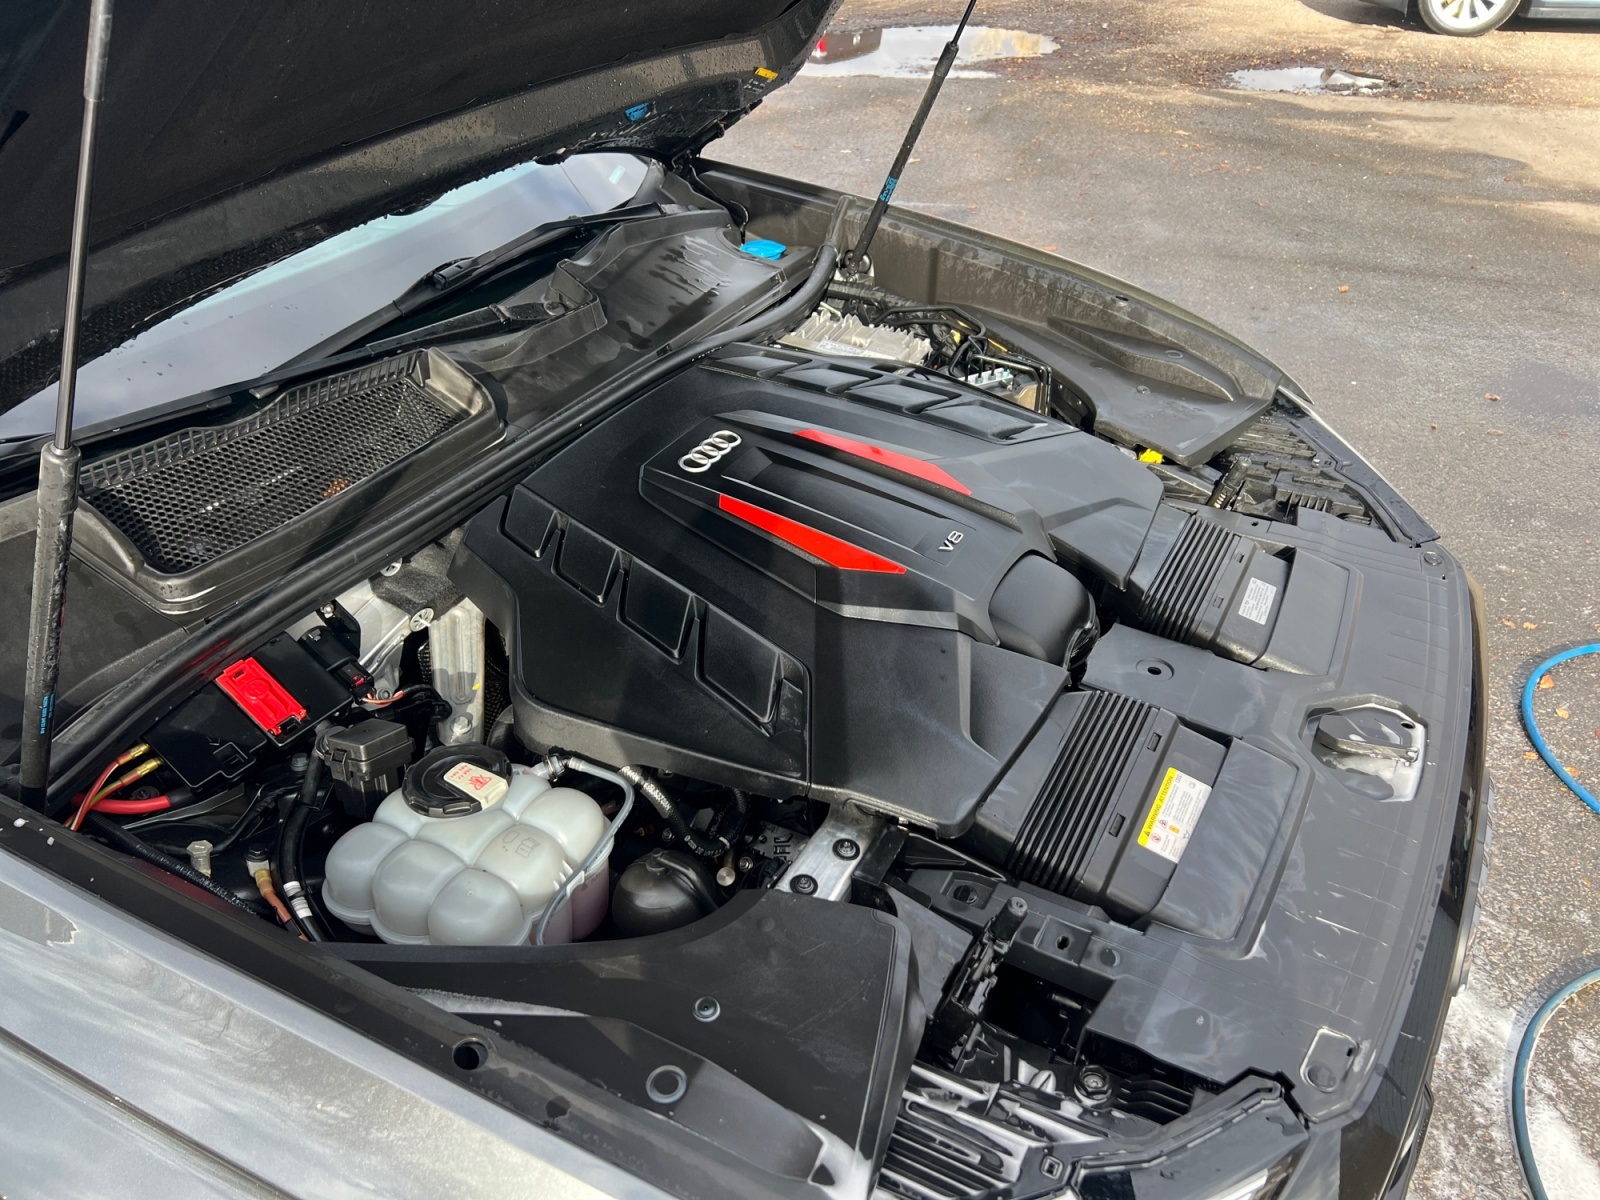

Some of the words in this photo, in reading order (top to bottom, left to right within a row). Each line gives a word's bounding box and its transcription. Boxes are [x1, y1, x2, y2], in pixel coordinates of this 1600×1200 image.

[938, 530, 964, 551] V8
[1147, 804, 1161, 829] WARNING
[1159, 776, 1173, 803] ATTENTION
